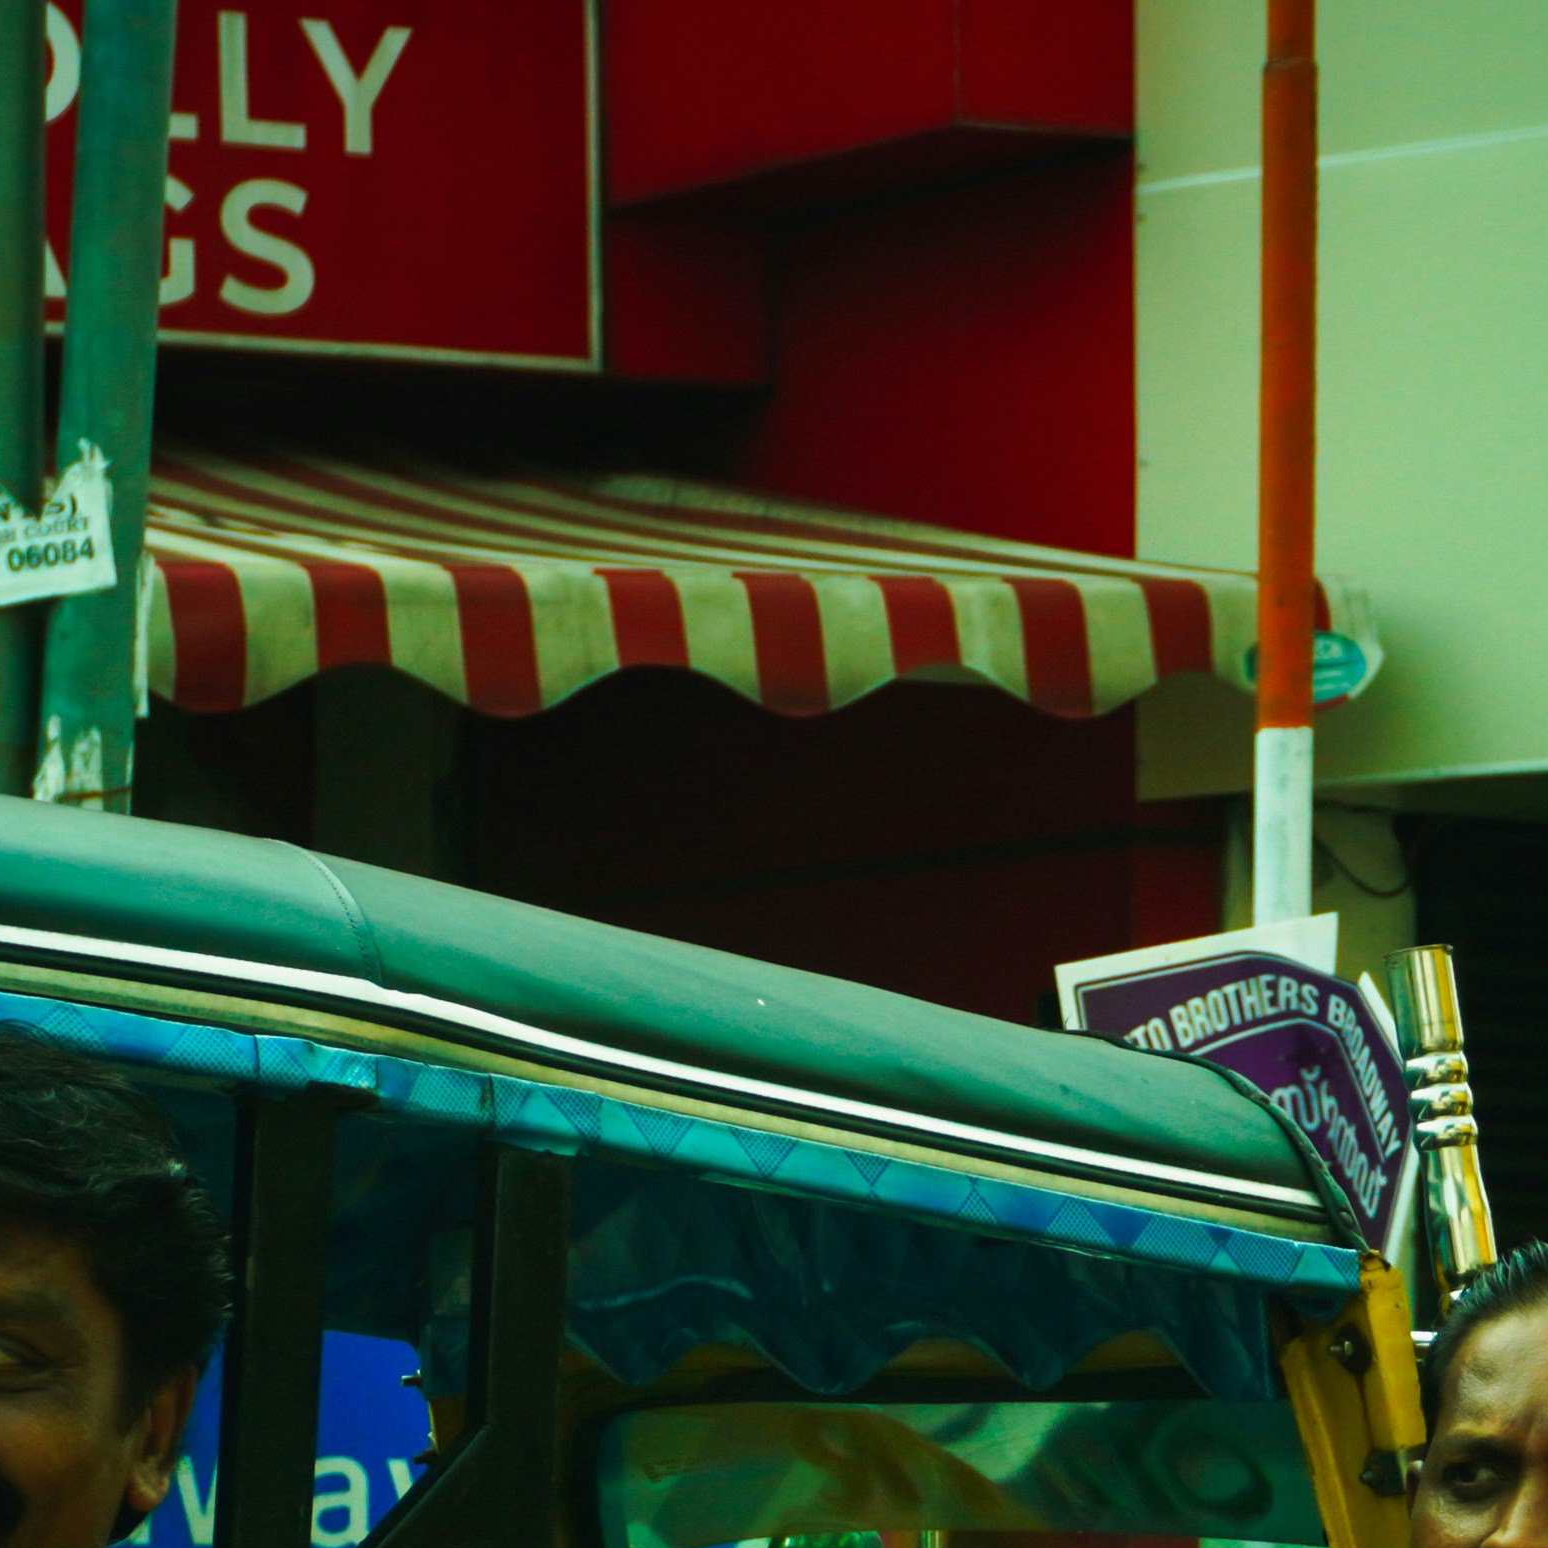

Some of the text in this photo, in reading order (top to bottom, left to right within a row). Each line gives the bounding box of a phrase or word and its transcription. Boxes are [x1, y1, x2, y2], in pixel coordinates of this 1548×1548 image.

[23, 515, 90, 538] COURT
[7, 537, 95, 572] 06084
[1169, 973, 1320, 1050] BROTHERS
[1327, 993, 1403, 1160] BROADWAY
